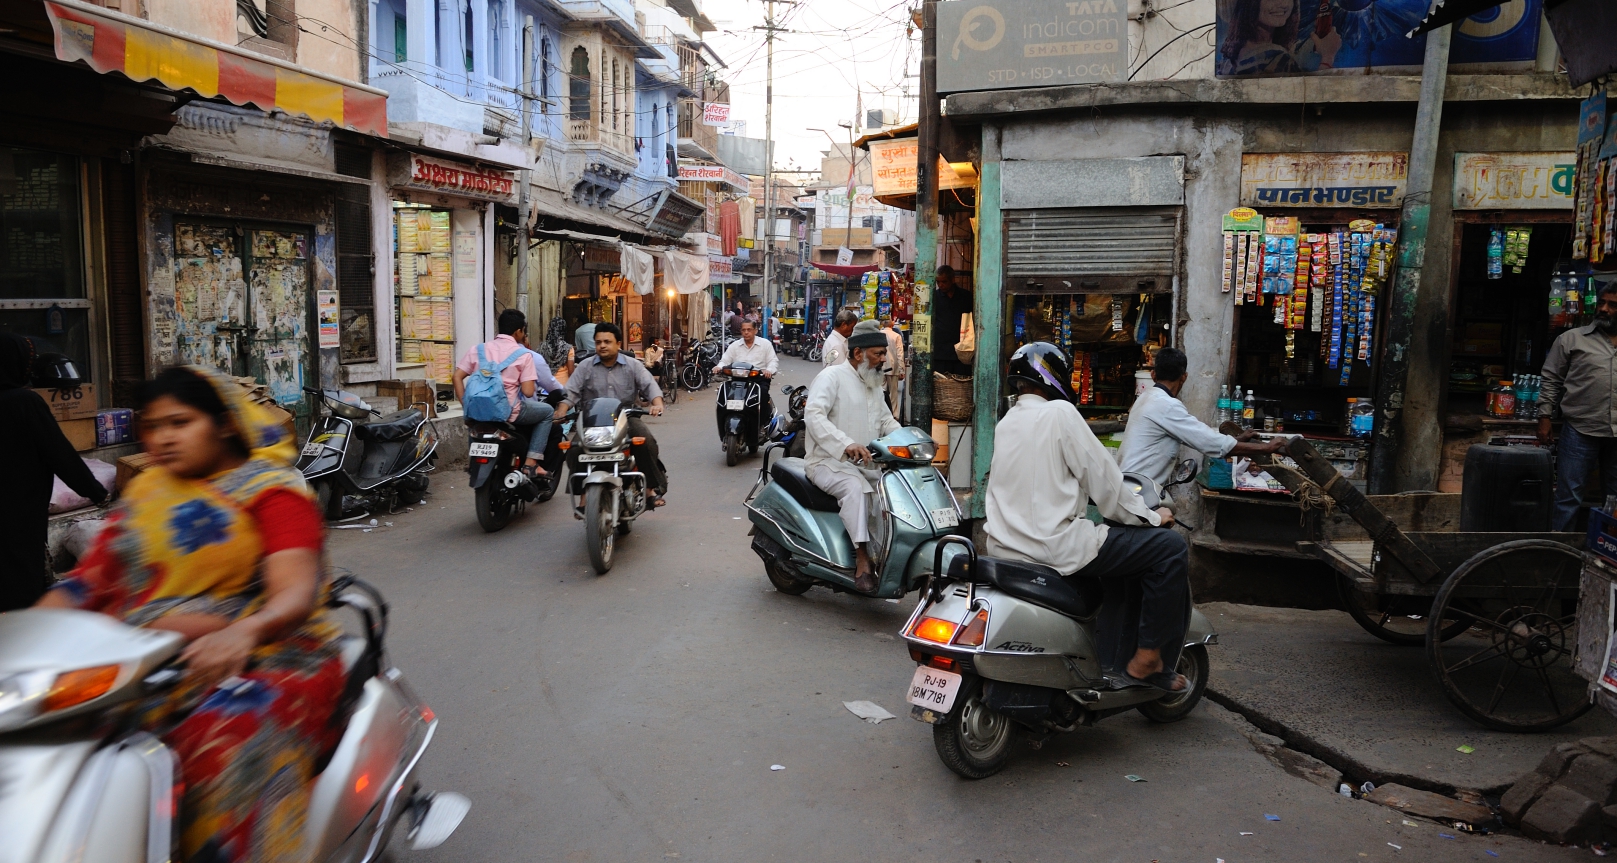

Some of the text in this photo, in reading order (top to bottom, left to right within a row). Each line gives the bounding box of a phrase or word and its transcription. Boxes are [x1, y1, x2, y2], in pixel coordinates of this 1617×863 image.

[1065, 0, 1119, 15] TATA
[1023, 15, 1119, 39] indicom
[1029, 42, 1114, 55] SMART PCO
[988, 63, 1119, 82] STD ISD LOCAL
[413, 158, 460, 188] अक्षय
[677, 167, 698, 178] रिहन्त
[48, 387, 83, 402] 786
[1603, 541, 1617, 555] PEP
[994, 641, 1045, 652] Activa
